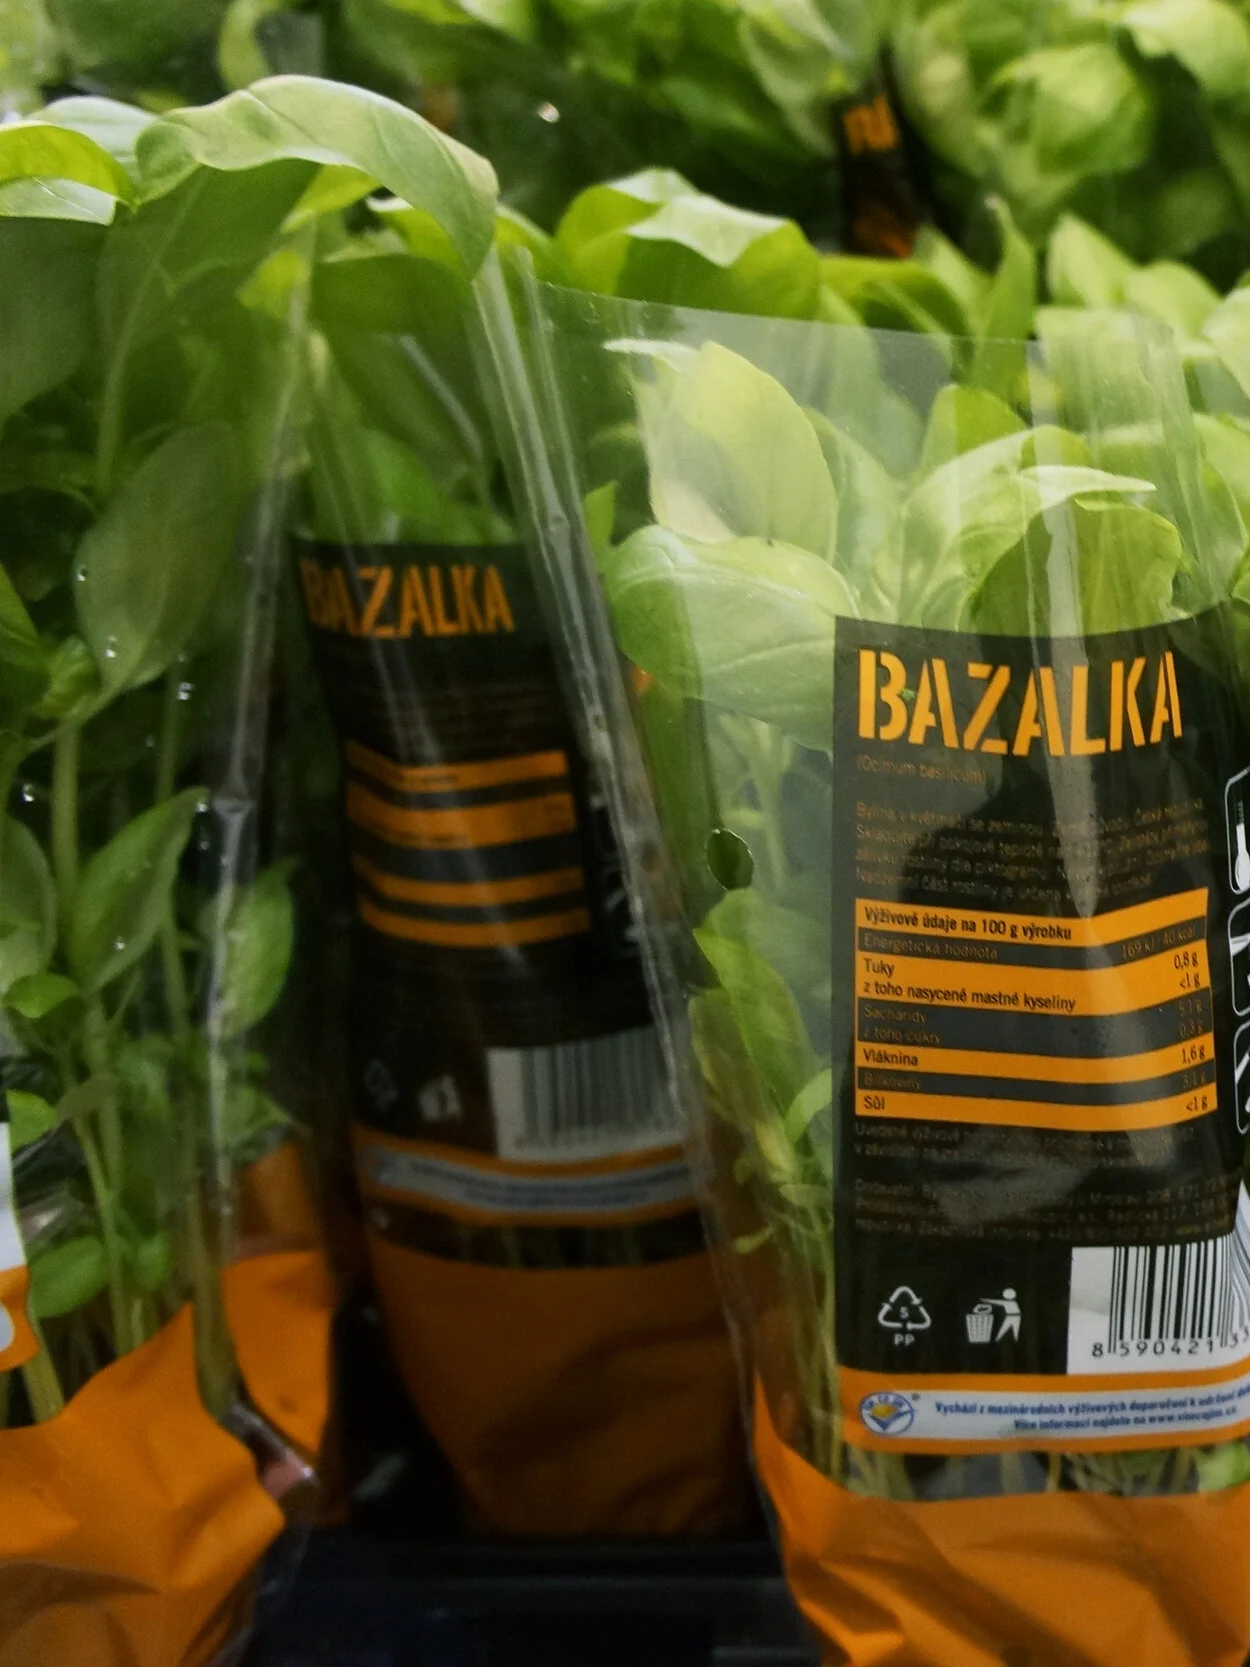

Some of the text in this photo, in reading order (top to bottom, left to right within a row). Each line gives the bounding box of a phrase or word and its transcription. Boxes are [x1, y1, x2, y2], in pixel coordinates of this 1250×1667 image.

[858, 649, 1183, 757] BAZALKA
[864, 906, 1071, 940] Výživové údaje na 100 g výrobku
[945, 943, 998, 958] hodnota
[864, 951, 1198, 978] Tuky 0,8 g
[863, 973, 1200, 1013] z toho nasycené mastné kyseliny <1 g
[863, 1045, 1206, 1066] Vláknina 1,6 g
[863, 1095, 1208, 1112] Sůl <1 g
[894, 1333, 915, 1346] PP
[1092, 1339, 1215, 1358] 8 590421
